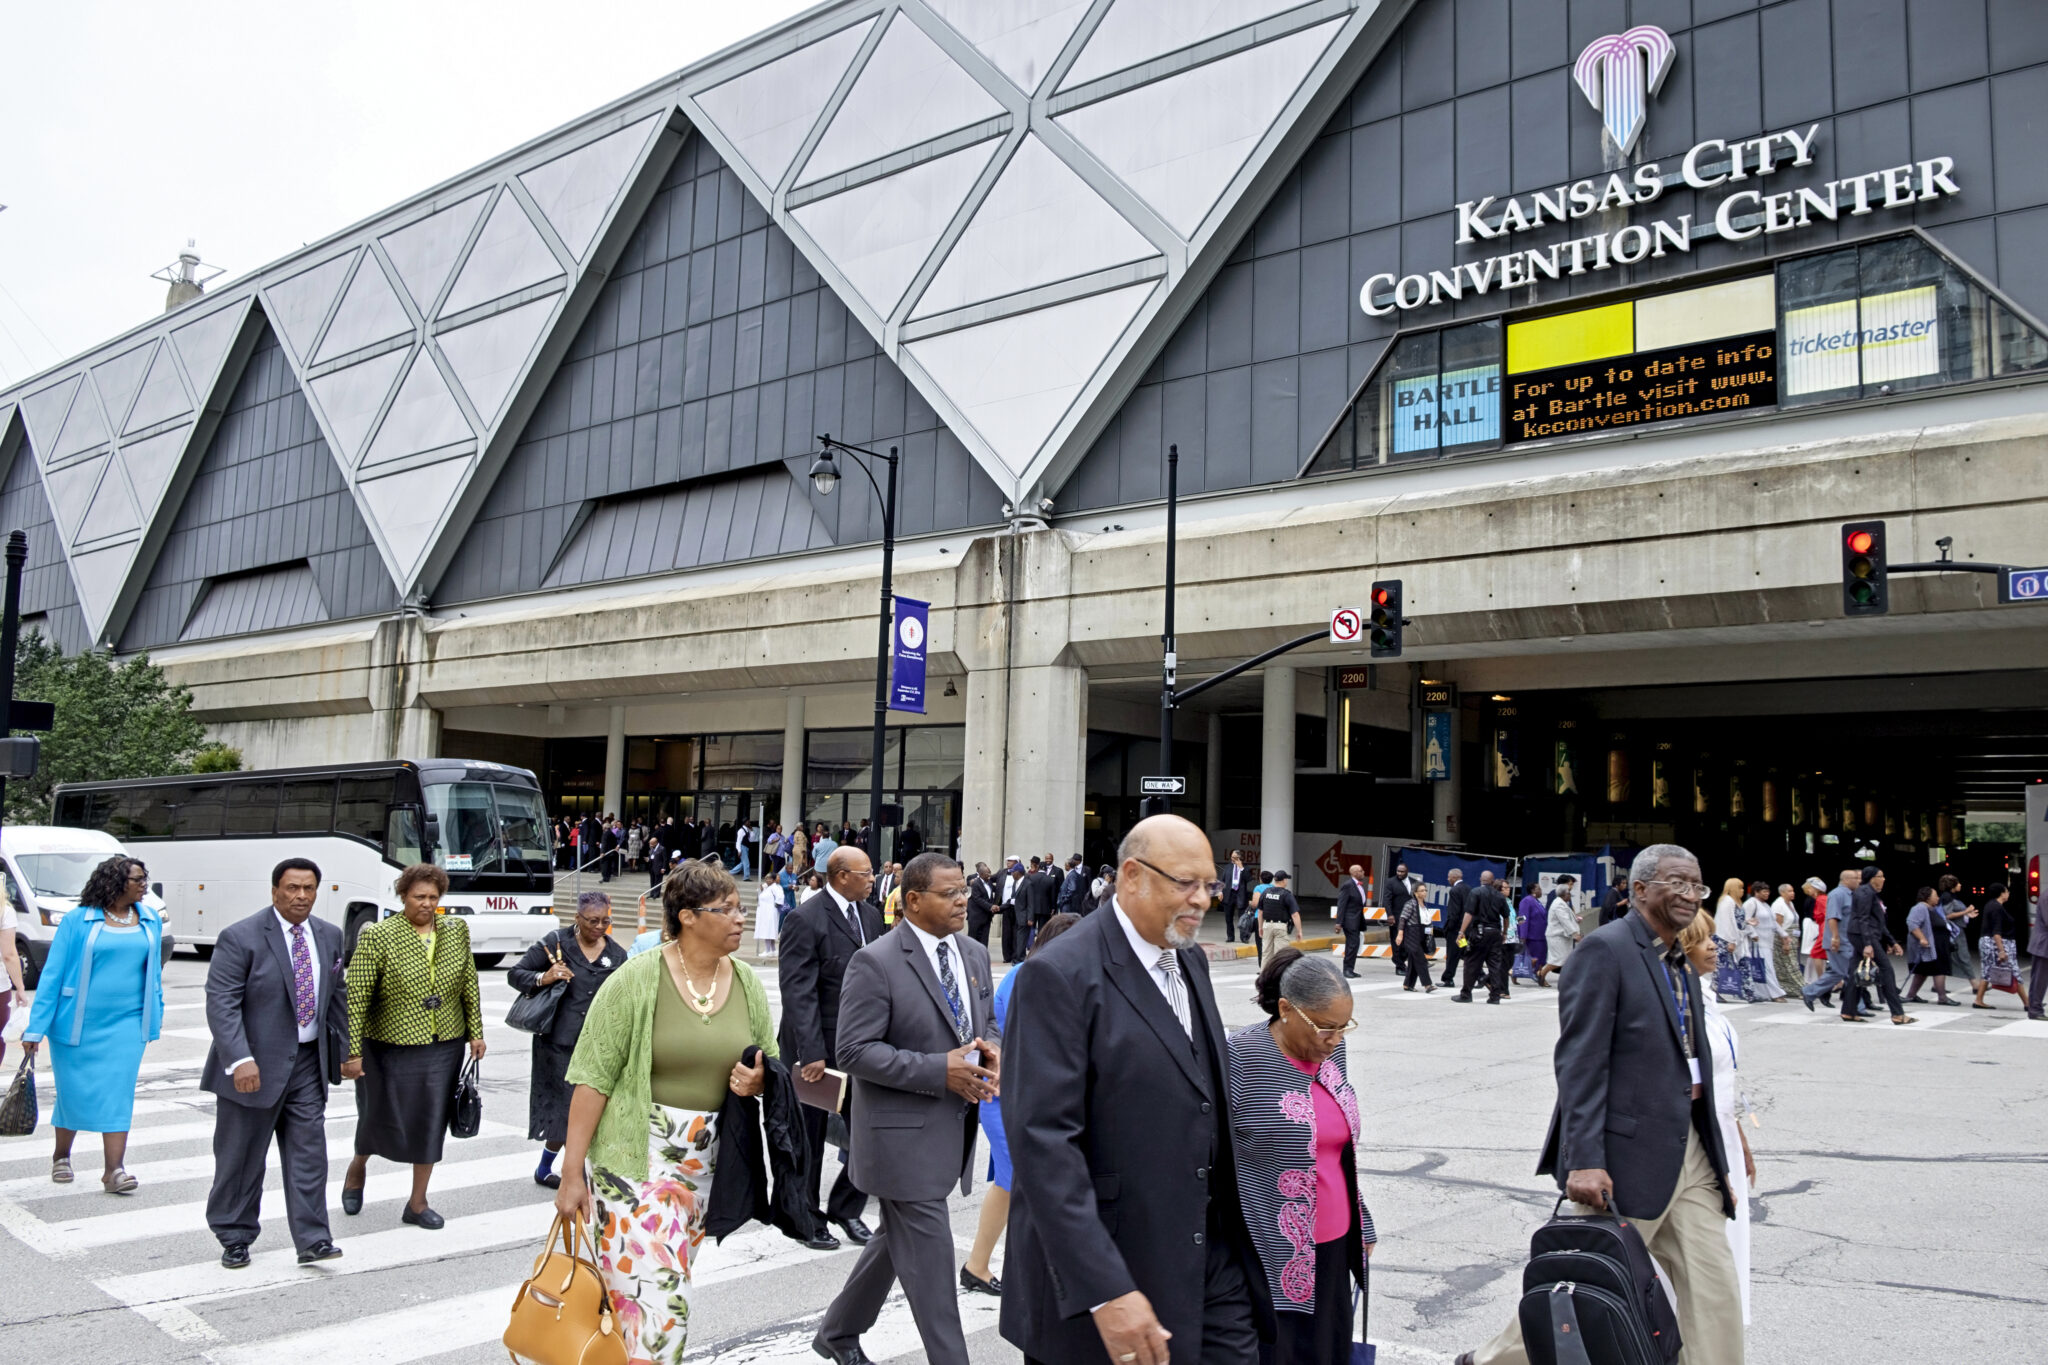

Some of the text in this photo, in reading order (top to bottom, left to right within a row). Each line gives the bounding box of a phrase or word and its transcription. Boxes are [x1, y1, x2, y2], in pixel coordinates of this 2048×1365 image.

[1455, 124, 1819, 245] KANSAS CITY
[1359, 156, 1961, 317] CONVENTION CENTER
[1788, 317, 1936, 357] ticketmaster
[1513, 344, 1773, 399] For up to date info
[1397, 375, 1500, 408] BARTLE
[1512, 369, 1773, 421] at Bartle visit www.
[1413, 406, 1485, 431] HALL
[1342, 673, 1365, 684] 2200
[1425, 692, 1448, 701] 2200
[1497, 707, 1517, 716] 2200
[1224, 848, 1261, 863] LBBY
[486, 896, 519, 911] MDK
[1265, 893, 1280, 901] POLICE
